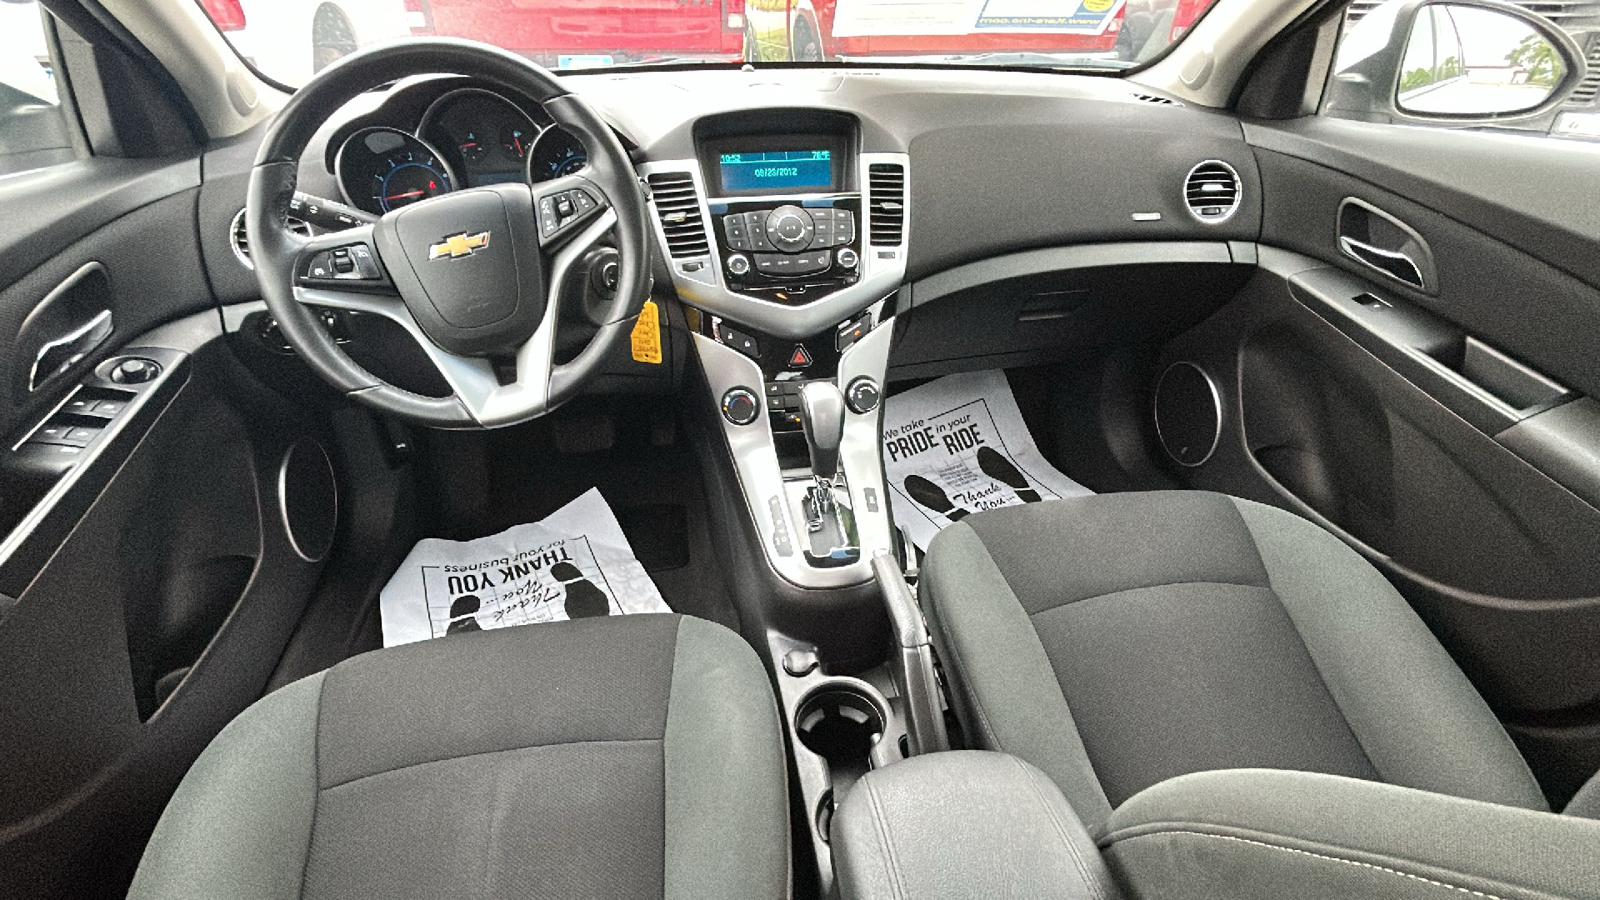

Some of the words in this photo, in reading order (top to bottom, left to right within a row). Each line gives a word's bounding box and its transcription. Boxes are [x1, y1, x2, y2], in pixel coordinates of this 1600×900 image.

[883, 429, 899, 440] We
[900, 419, 925, 434] take
[935, 424, 946, 434] in
[947, 414, 971, 431] your
[886, 426, 940, 462] PRIDE
[942, 423, 985, 455] RIDE
[952, 482, 1001, 504] Thank
[514, 546, 545, 562] your
[546, 539, 565, 549] for
[444, 557, 509, 573] business
[498, 546, 573, 584] THANK
[447, 572, 496, 595] YOU
[492, 587, 561, 622] Thank
